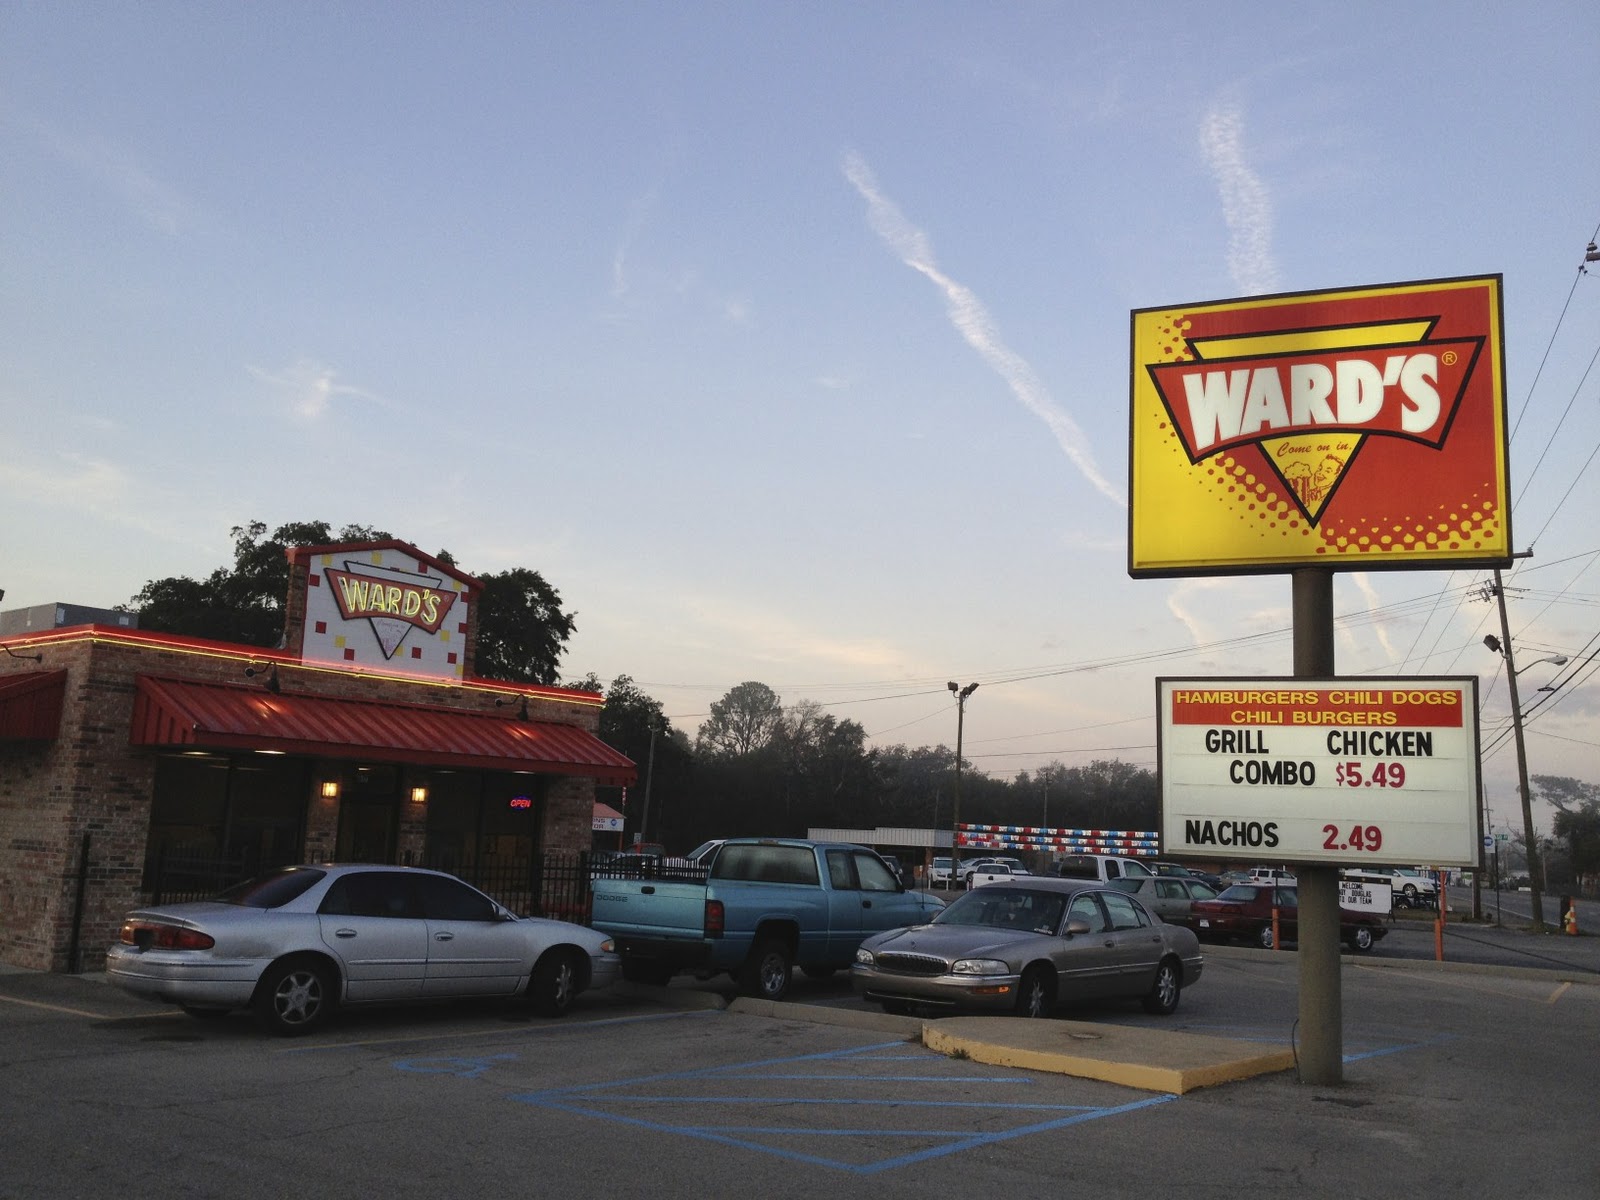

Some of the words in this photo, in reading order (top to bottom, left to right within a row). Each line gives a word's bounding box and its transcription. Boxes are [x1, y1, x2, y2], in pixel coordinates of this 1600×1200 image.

[1182, 353, 1441, 451] WARD'S
[1277, 442, 1312, 457] Come
[337, 576, 441, 626] WARD'S
[1176, 691, 1319, 705] HAMBURGERS
[1328, 691, 1383, 705] CHILI
[1392, 691, 1458, 705] DOGS
[1231, 710, 1283, 724] CHILI
[1292, 711, 1398, 725] BURGERS
[1205, 729, 1269, 754] GRILL
[1327, 730, 1433, 757] CHICKEN
[1229, 759, 1316, 786] COMBO
[1335, 762, 1406, 788] $5.49
[1185, 820, 1279, 848] NACHOS
[1322, 824, 1383, 852] 2.49
